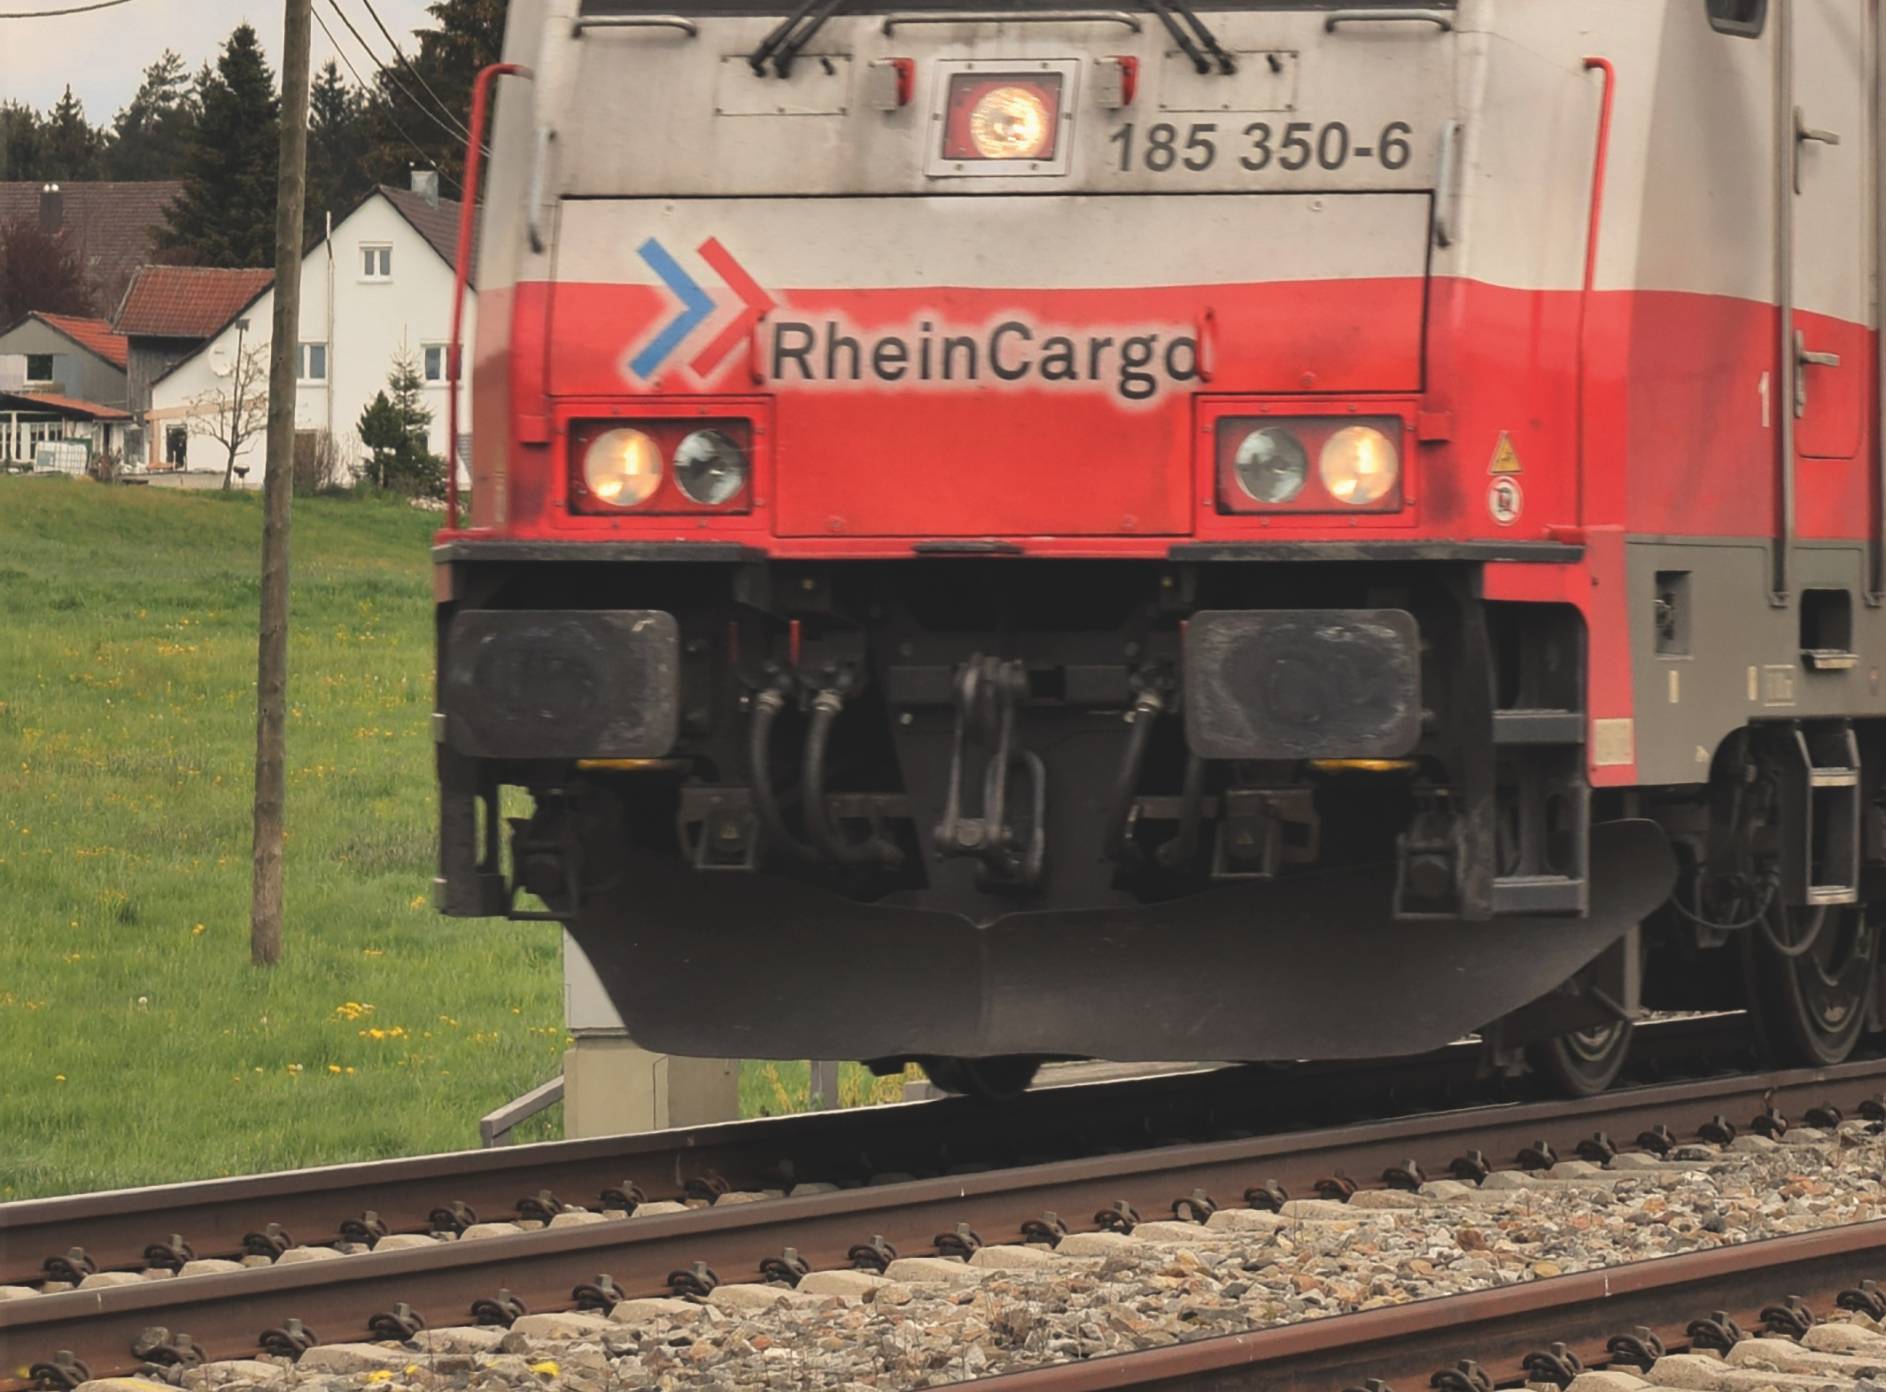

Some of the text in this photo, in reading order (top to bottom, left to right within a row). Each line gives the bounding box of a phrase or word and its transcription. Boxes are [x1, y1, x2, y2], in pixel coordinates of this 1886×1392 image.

[1110, 120, 1413, 172] 185 350-6
[771, 320, 1198, 400] RheinCargo
